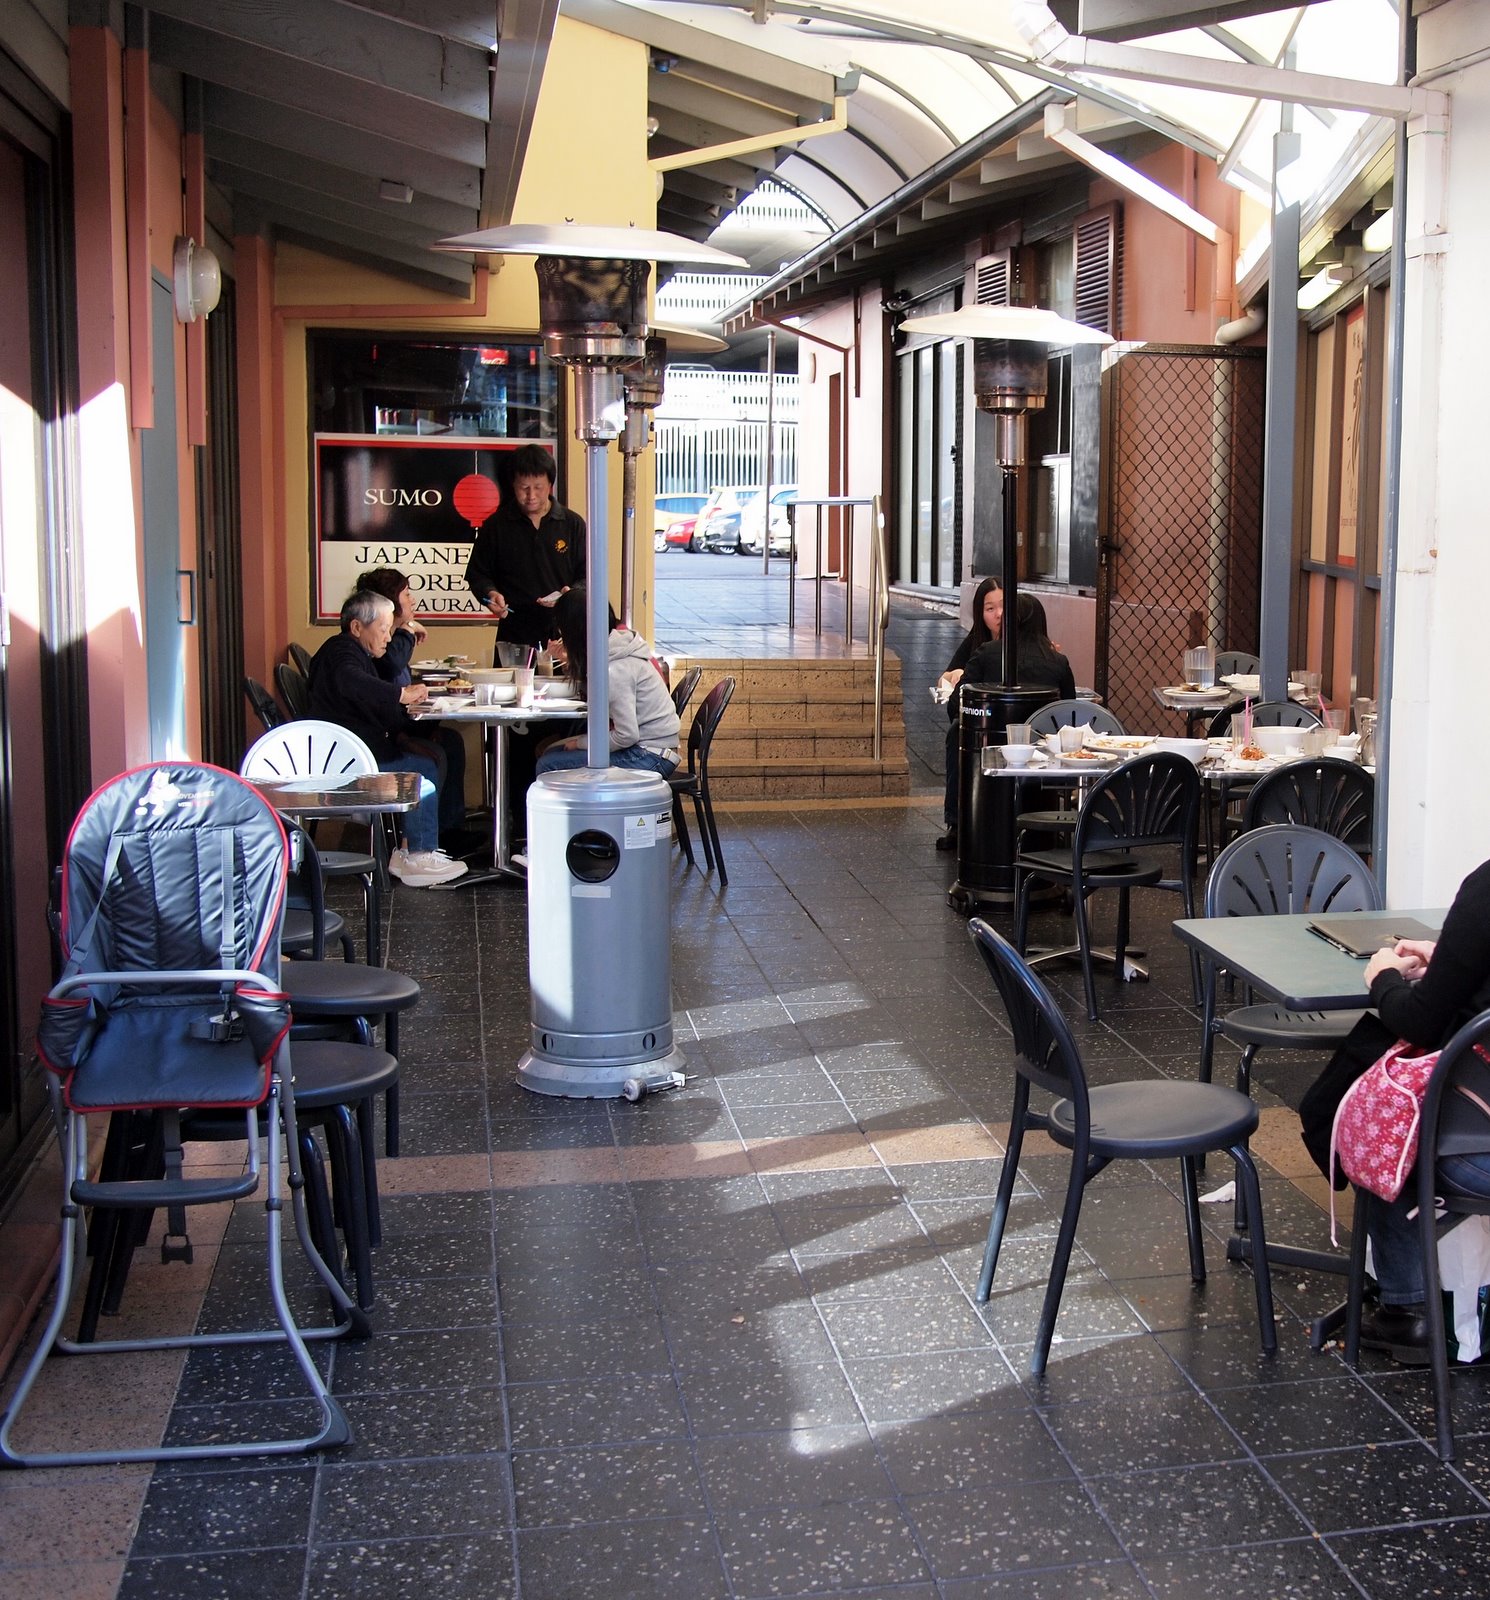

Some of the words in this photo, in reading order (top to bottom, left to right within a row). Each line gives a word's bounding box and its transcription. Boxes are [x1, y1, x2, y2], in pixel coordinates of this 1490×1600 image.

[364, 488, 442, 507] SUMO
[407, 574, 472, 591] ORE
[415, 599, 484, 612] AURA
